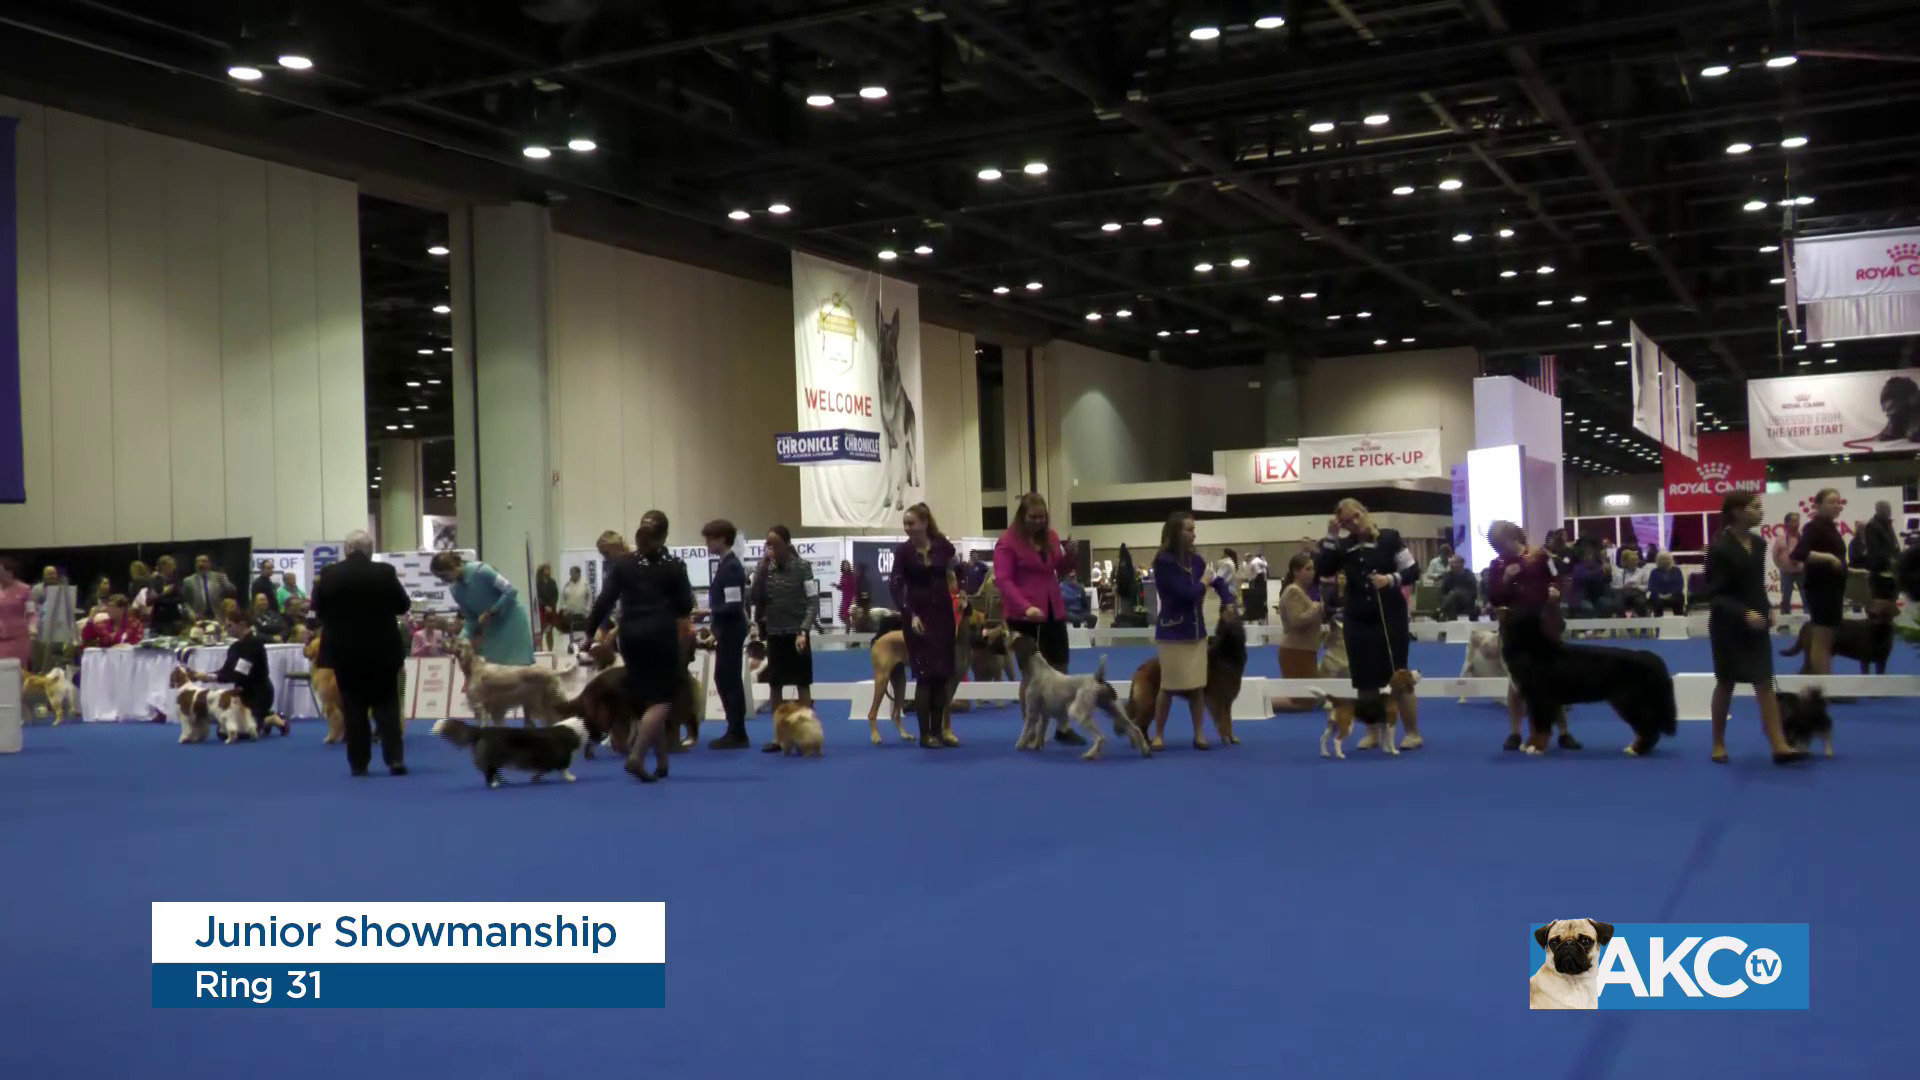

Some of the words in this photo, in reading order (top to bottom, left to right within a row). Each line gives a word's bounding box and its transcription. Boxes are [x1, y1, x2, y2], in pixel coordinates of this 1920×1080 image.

[1855, 265, 1905, 280] ROYAL
[804, 387, 872, 417] WELCOME
[1766, 427, 1786, 438] THE
[1787, 425, 1811, 437] VERY
[1814, 423, 1844, 436] START
[776, 435, 839, 455] CHRONICLE
[844, 435, 880, 454] CHRONICLE
[1311, 455, 1355, 469] PRIZE
[1359, 450, 1424, 467] PICK-UP
[1669, 482, 1713, 496] ROYAL
[1715, 480, 1762, 494] CANIN
[280, 558, 298, 569] OF
